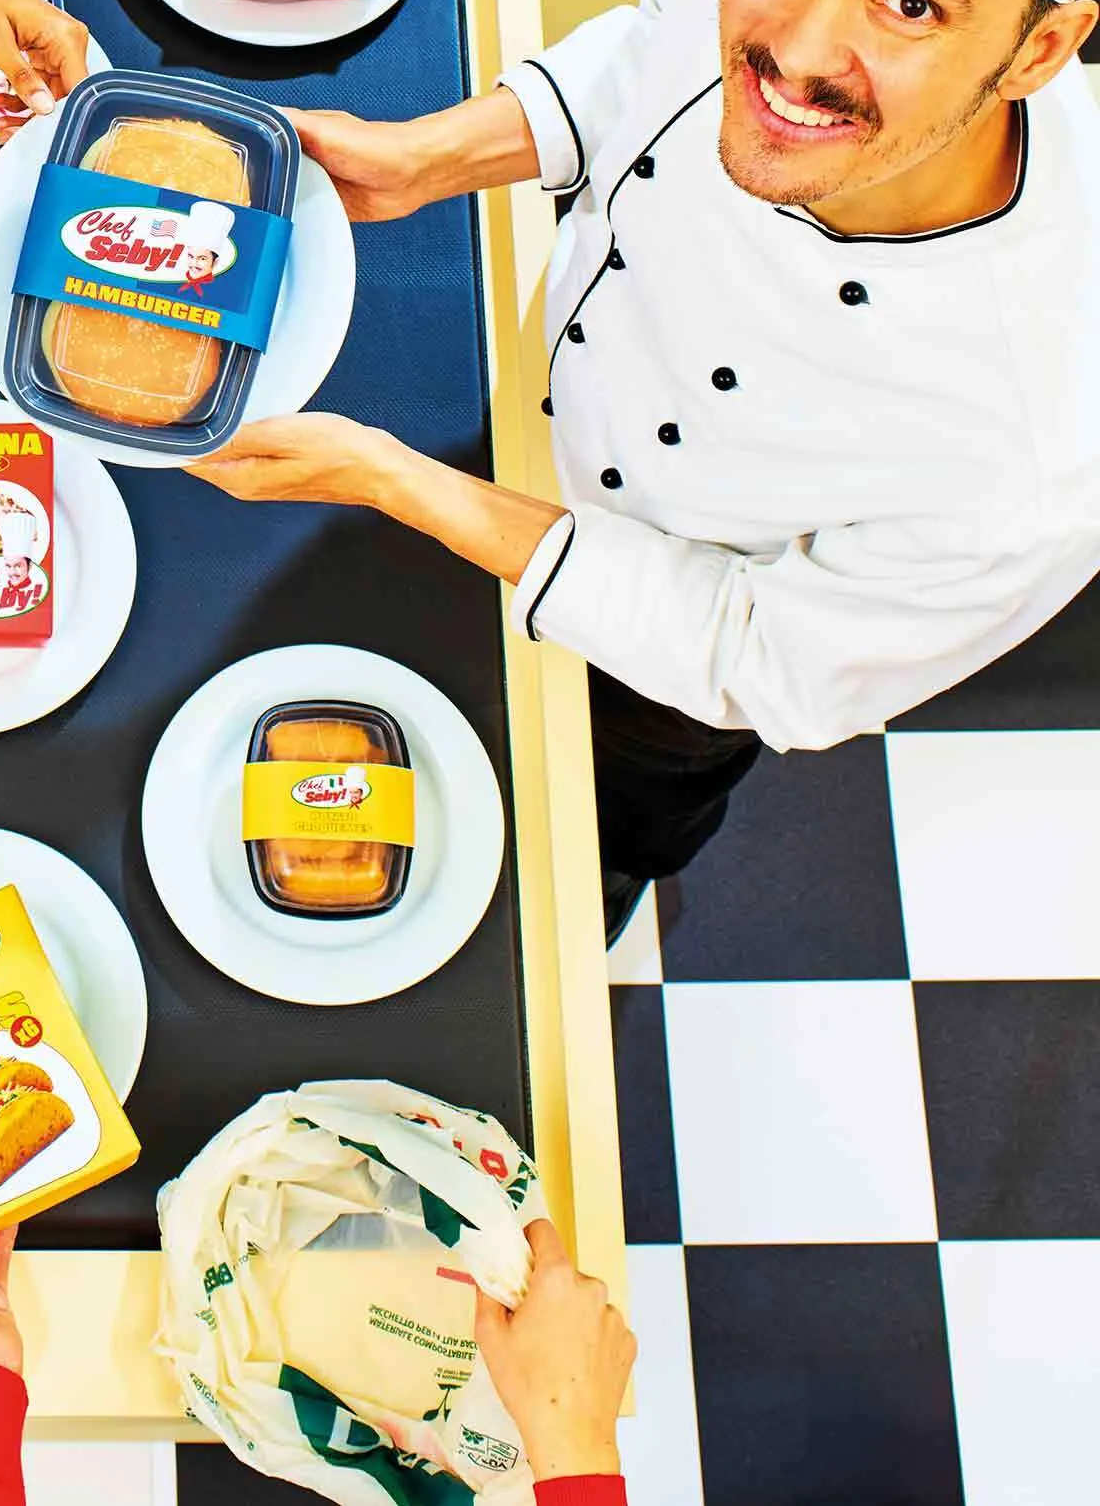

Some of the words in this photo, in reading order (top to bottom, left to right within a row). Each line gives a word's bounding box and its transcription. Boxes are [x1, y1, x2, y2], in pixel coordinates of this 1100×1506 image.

[76, 210, 137, 241] Chef
[85, 235, 186, 272] Seby!
[63, 276, 222, 328] HAMBURGER
[298, 780, 324, 792] Chef
[304, 789, 347, 804] Seby!
